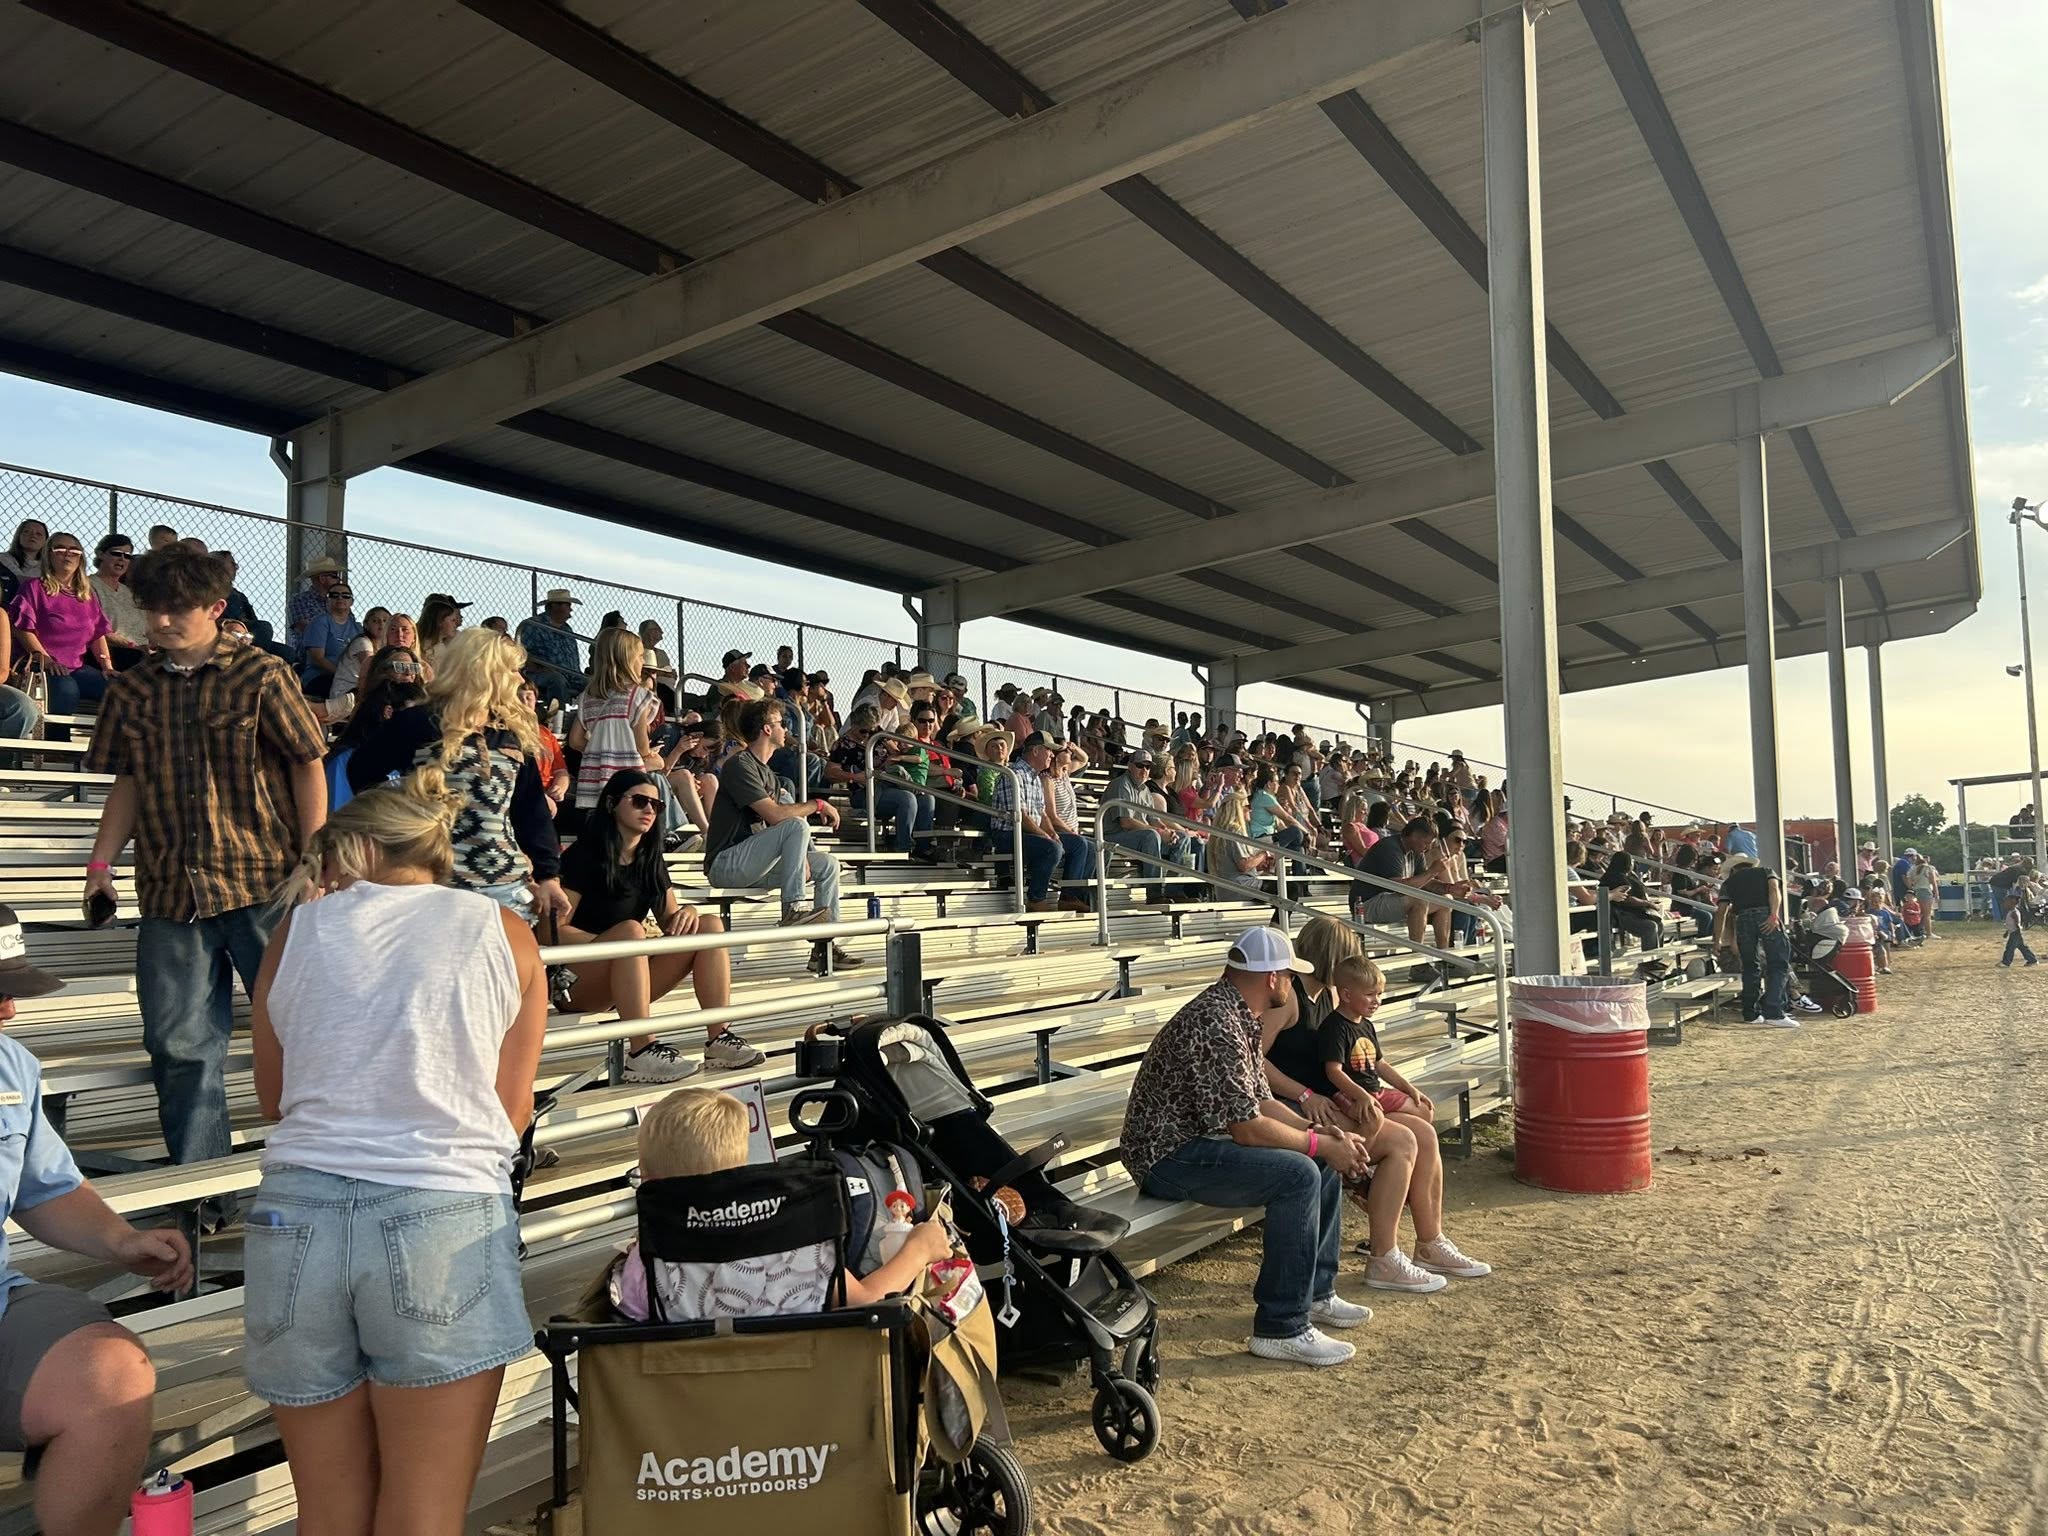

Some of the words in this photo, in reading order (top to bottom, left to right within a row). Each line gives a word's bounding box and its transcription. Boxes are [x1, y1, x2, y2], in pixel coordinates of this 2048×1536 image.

[687, 1197, 781, 1222] Academy
[637, 1444, 830, 1486] Academy
[636, 1477, 809, 1501] SPORTS+OUTDOORS
